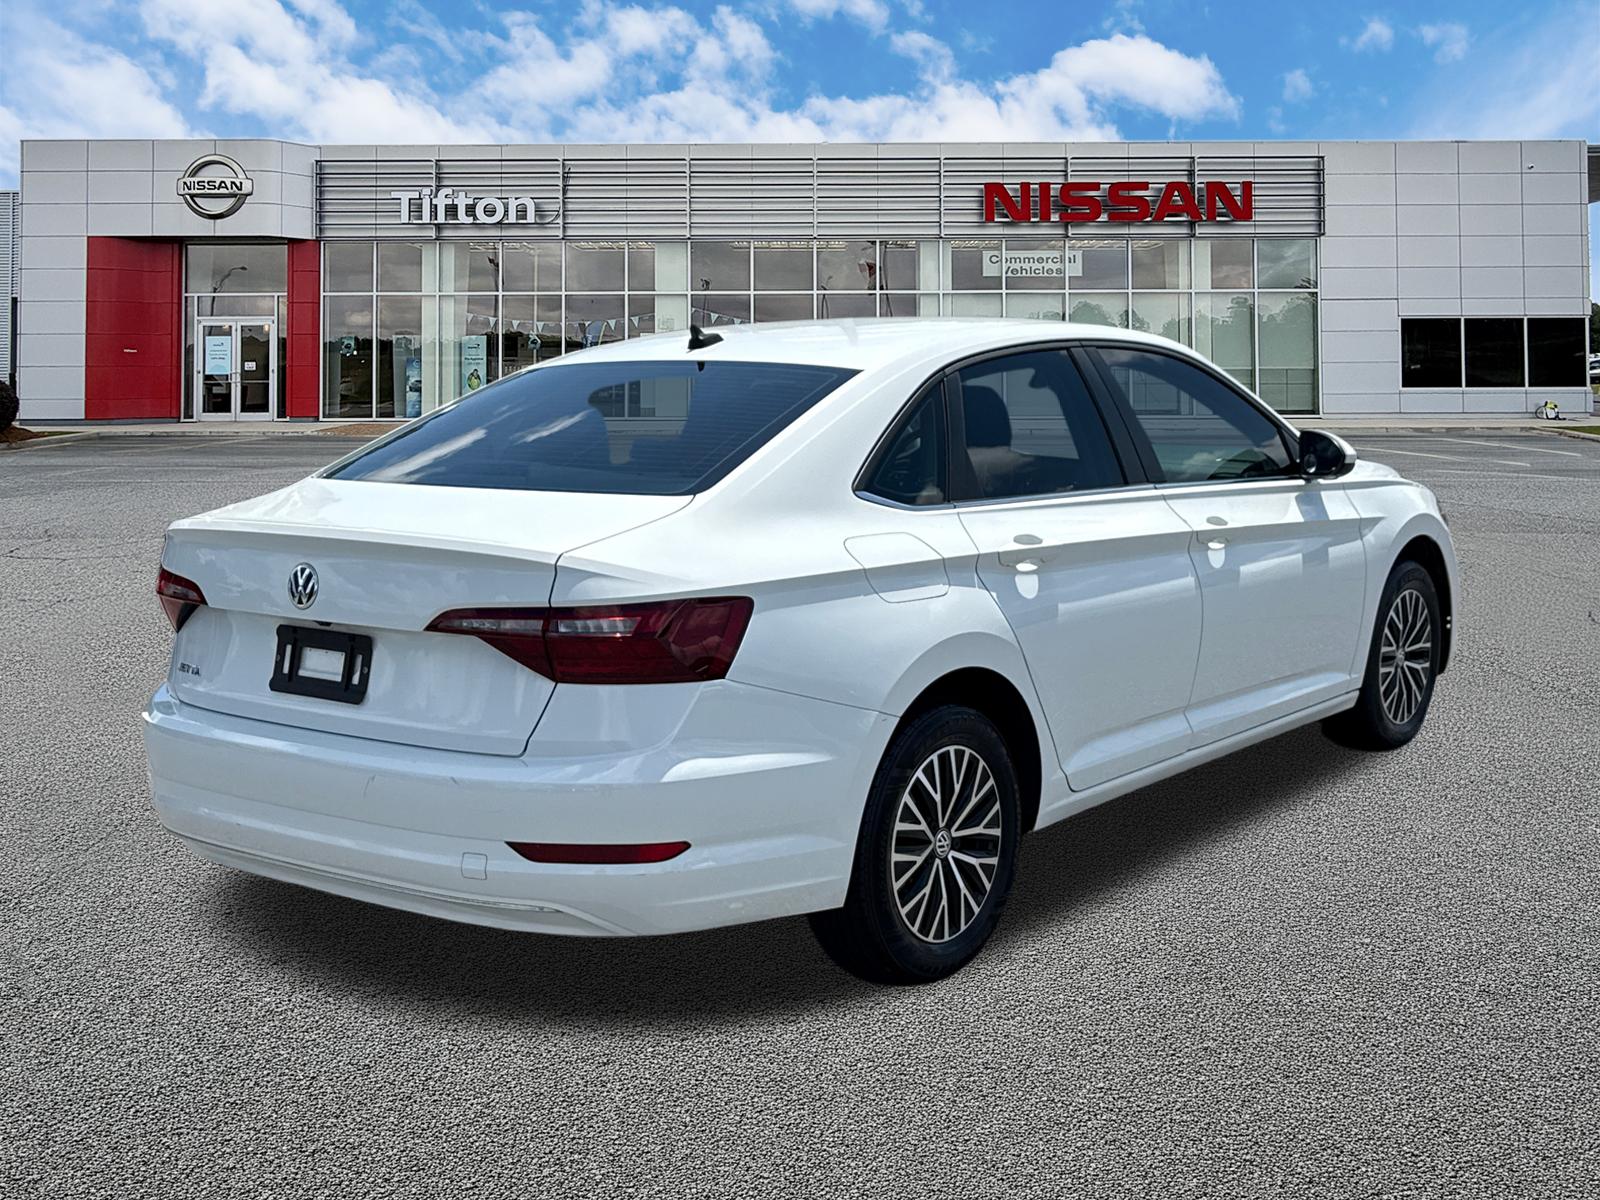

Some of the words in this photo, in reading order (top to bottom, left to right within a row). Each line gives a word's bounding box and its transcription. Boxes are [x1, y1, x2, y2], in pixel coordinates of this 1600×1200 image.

[182, 180, 243, 191] NISSAN
[984, 181, 1253, 222] NISSAN
[391, 187, 536, 224] Tifton
